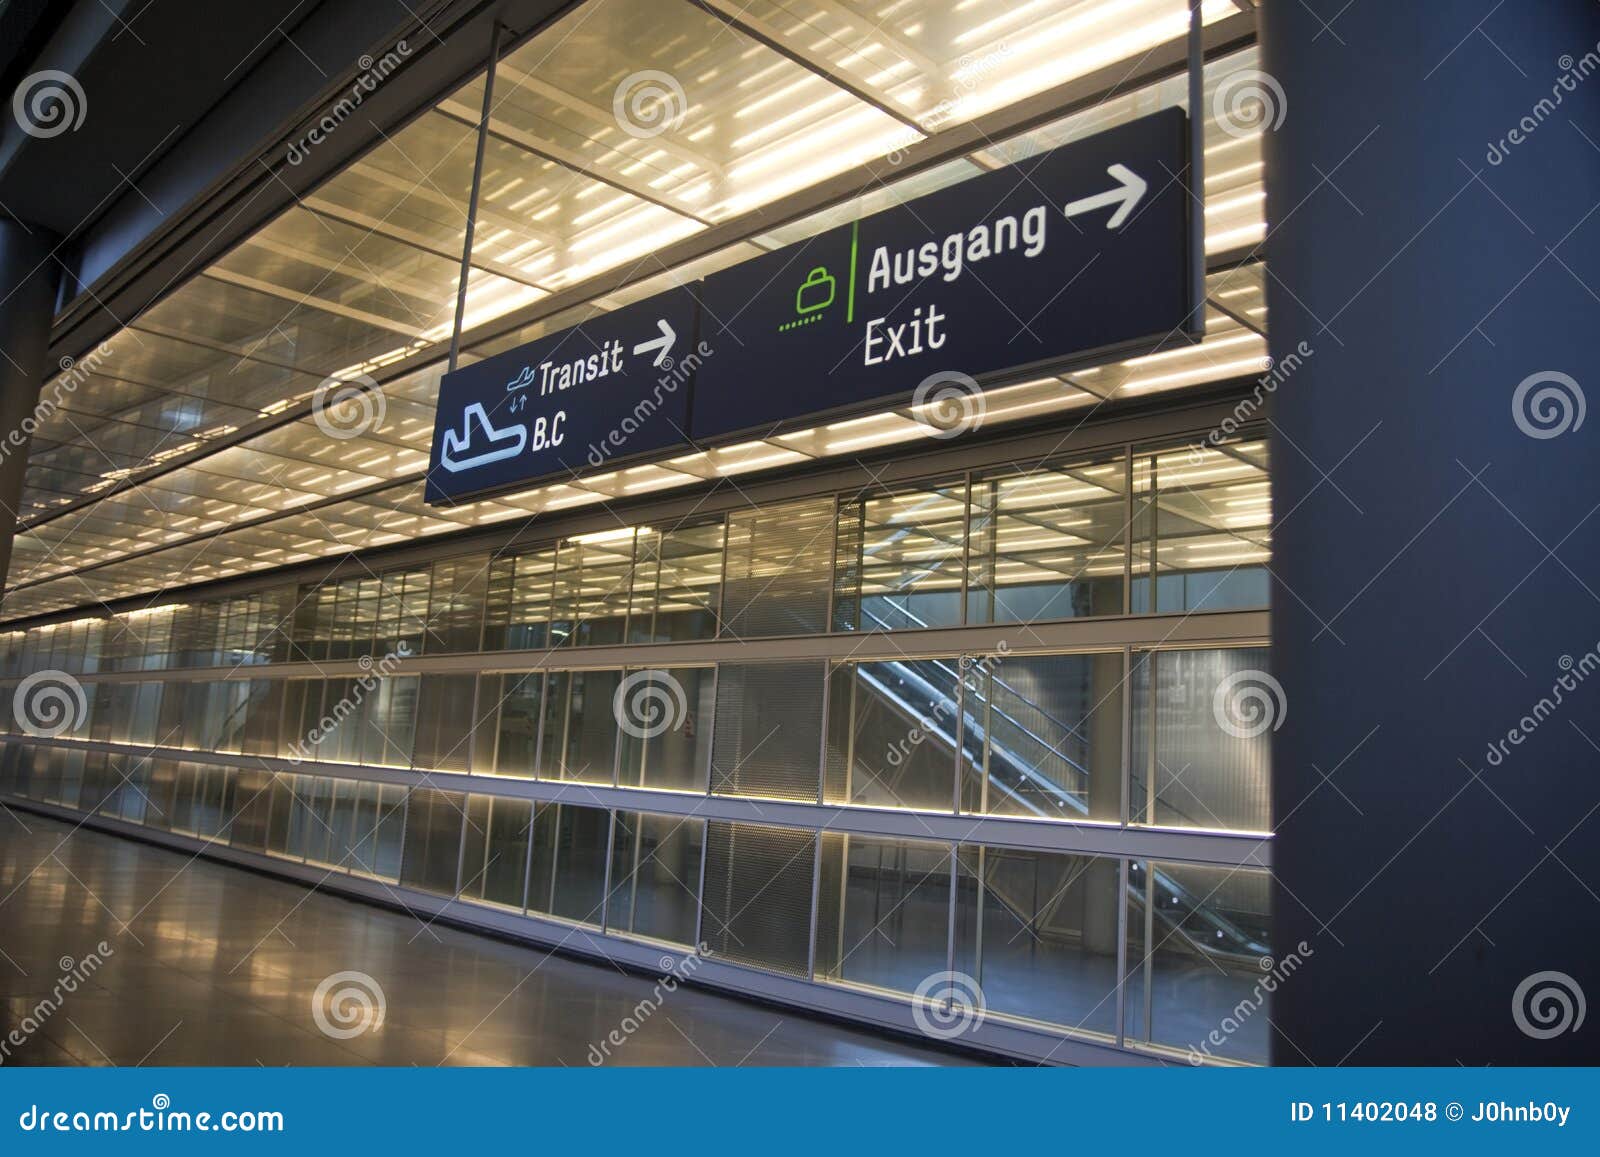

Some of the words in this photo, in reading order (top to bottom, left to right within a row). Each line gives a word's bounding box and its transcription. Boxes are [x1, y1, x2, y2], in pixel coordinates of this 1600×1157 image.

[867, 205, 1047, 294] Ausgang
[864, 303, 946, 366] Exit
[540, 339, 624, 396] Transit
[532, 410, 566, 452] B.C
